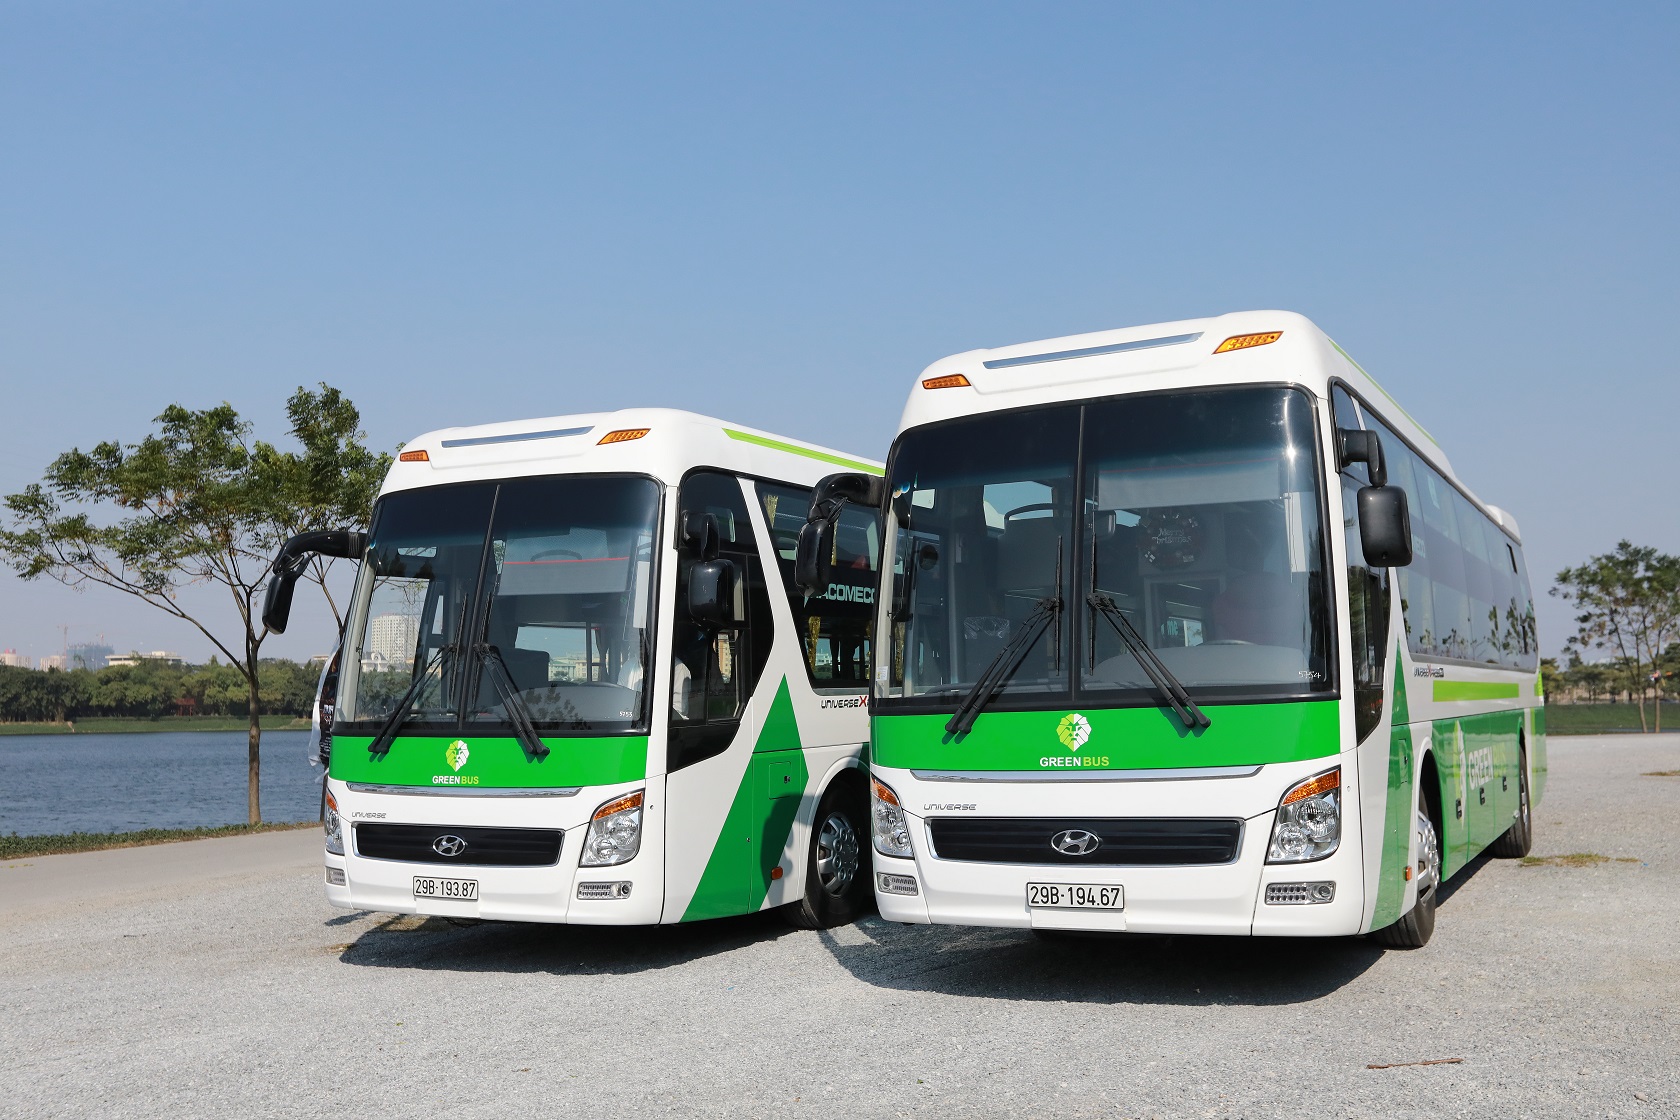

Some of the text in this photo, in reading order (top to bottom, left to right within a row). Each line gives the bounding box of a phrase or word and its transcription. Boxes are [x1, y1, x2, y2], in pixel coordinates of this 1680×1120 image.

[1039, 756, 1110, 767] GREEN BUS
[1468, 745, 1494, 791] GREEN
[432, 775, 480, 785] GREEN BUS
[923, 803, 977, 811] UNIVERSE
[415, 878, 476, 898] 29B-193.87
[1030, 885, 1120, 907] 29B-194.67
